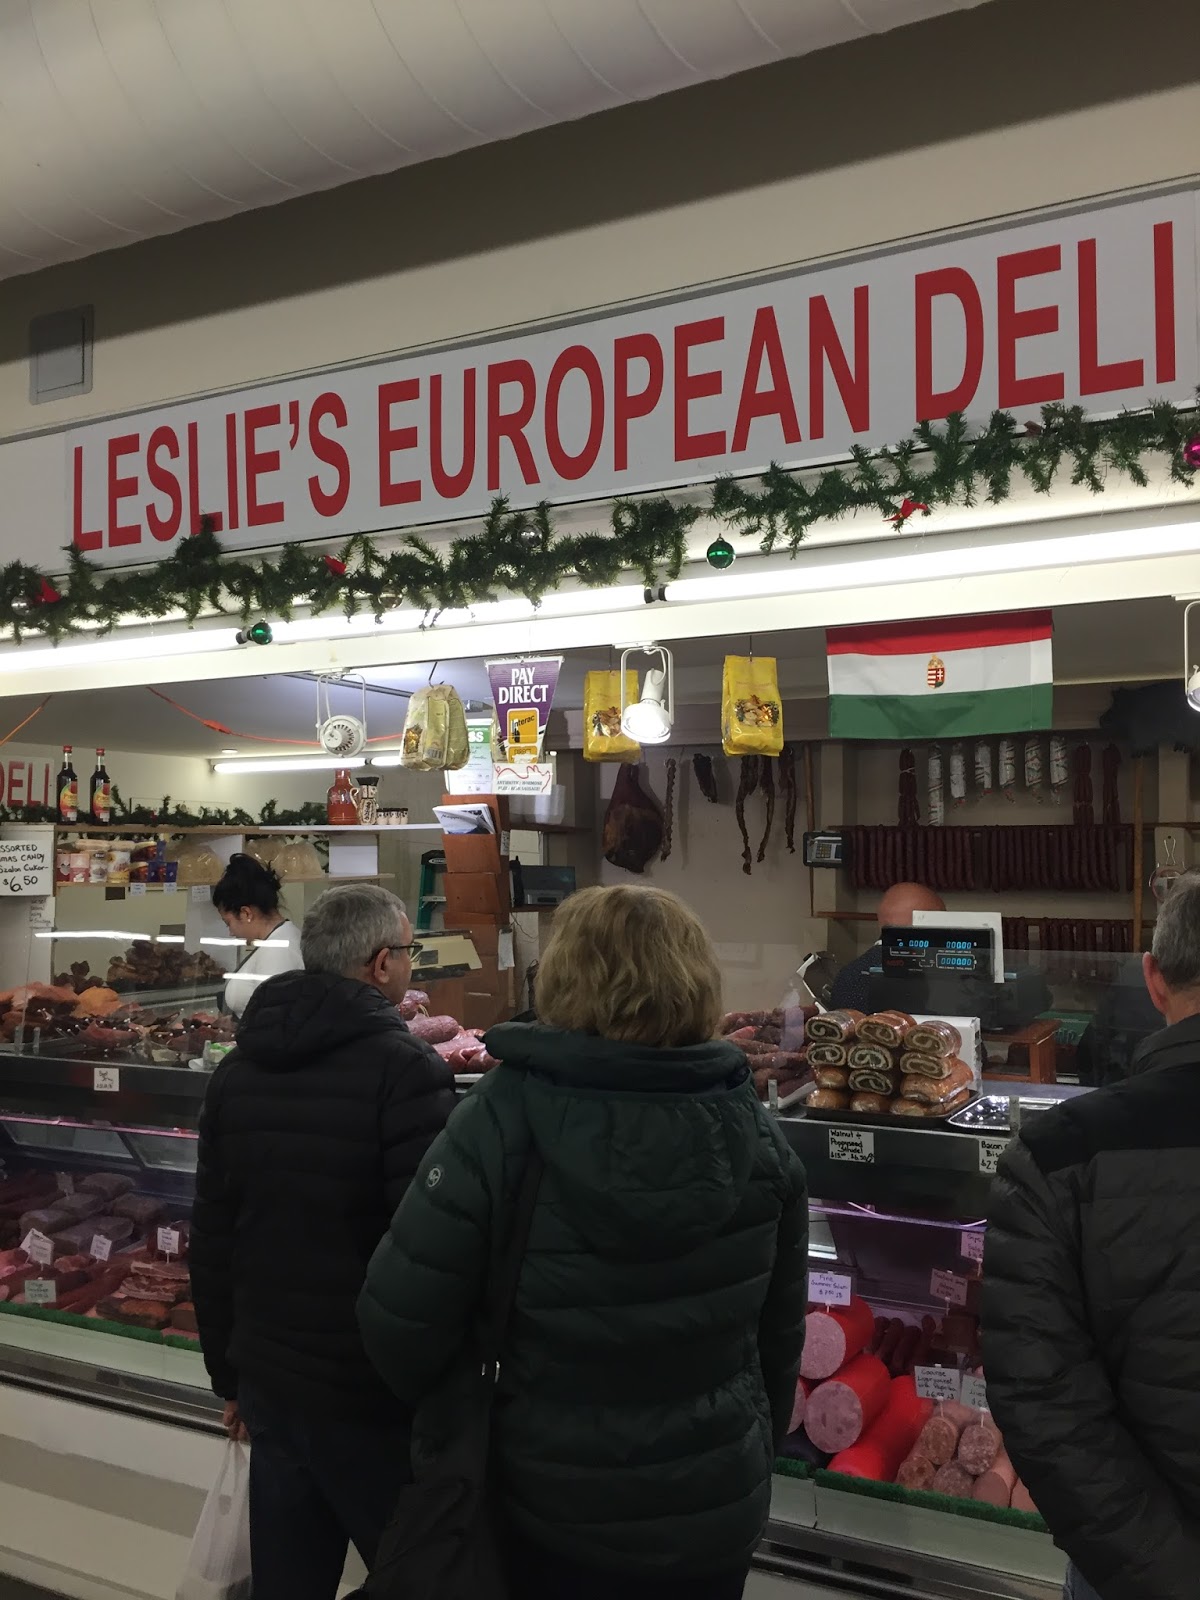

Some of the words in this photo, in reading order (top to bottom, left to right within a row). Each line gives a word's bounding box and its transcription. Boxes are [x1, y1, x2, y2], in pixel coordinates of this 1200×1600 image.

[74, 392, 350, 551] LESLIE'S
[378, 285, 870, 507] EUROPEAN
[915, 221, 1176, 422] DELI
[511, 667, 535, 686] PAY
[498, 684, 549, 704] DIRECT
[0, 760, 49, 808] ELI
[981, 1141, 1003, 1150] Bacon
